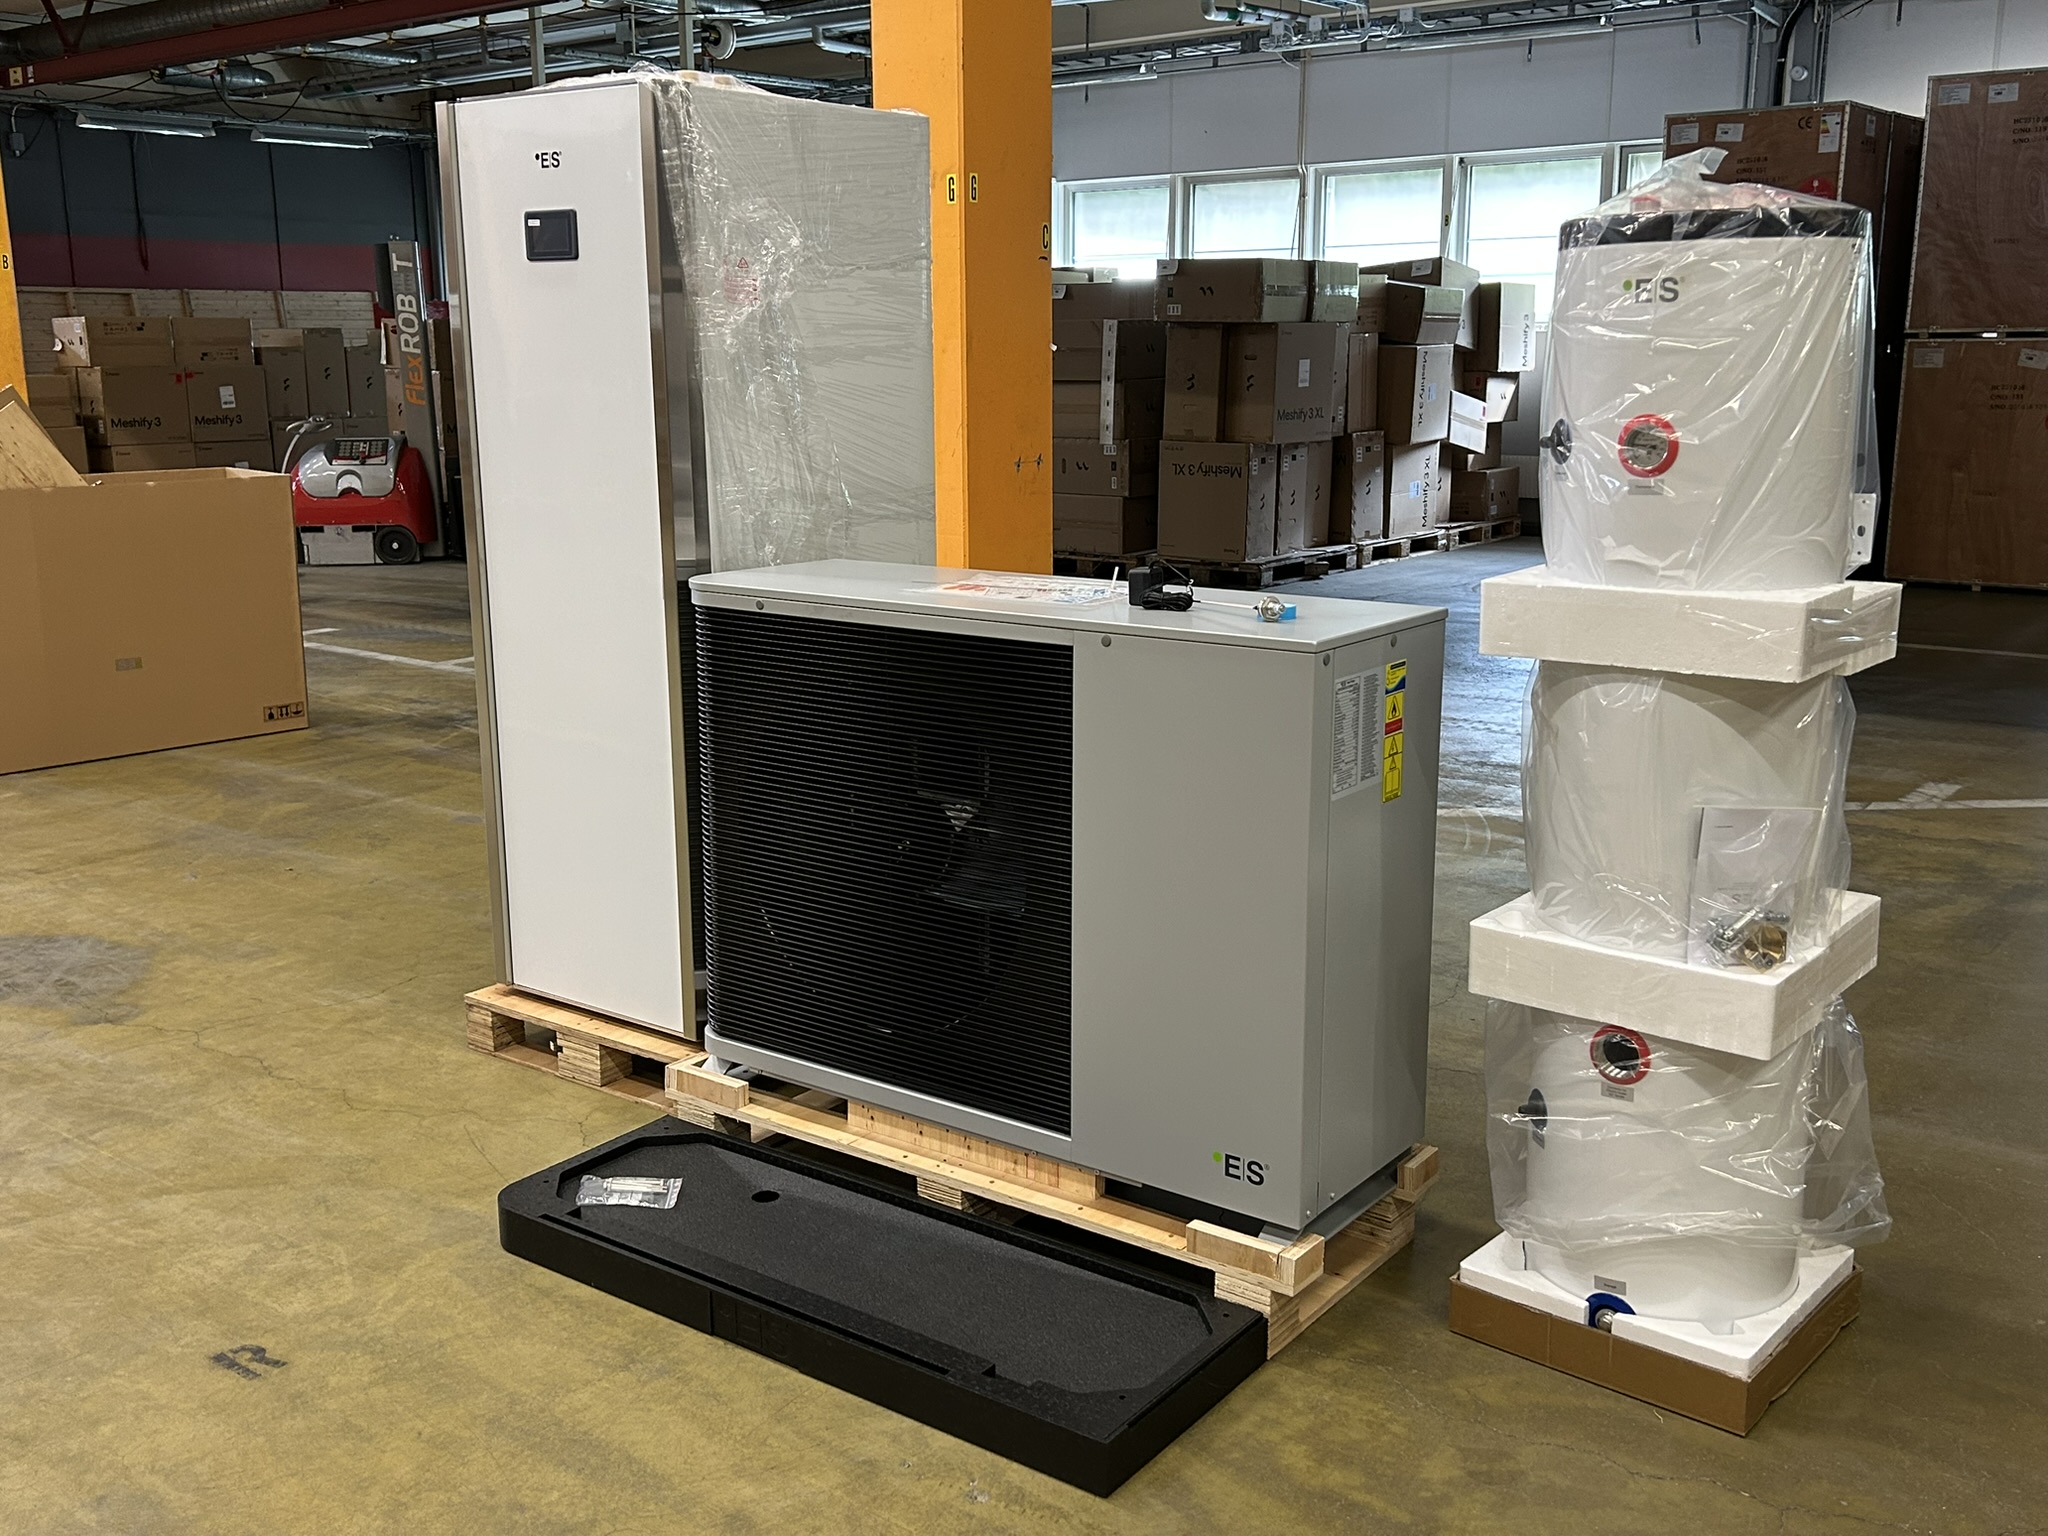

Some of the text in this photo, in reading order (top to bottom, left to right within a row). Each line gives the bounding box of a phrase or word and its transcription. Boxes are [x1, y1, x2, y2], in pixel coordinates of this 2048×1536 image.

[948, 176, 955, 202] G
[971, 175, 977, 201] G
[1042, 224, 1049, 250] C
[2, 254, 9, 270] B
[111, 416, 162, 430] Meshify 3
[194, 414, 243, 427] Meshify 3
[1276, 406, 1325, 423] Meshify 3 XL
[1172, 461, 1242, 478] Meshify 3 XL
